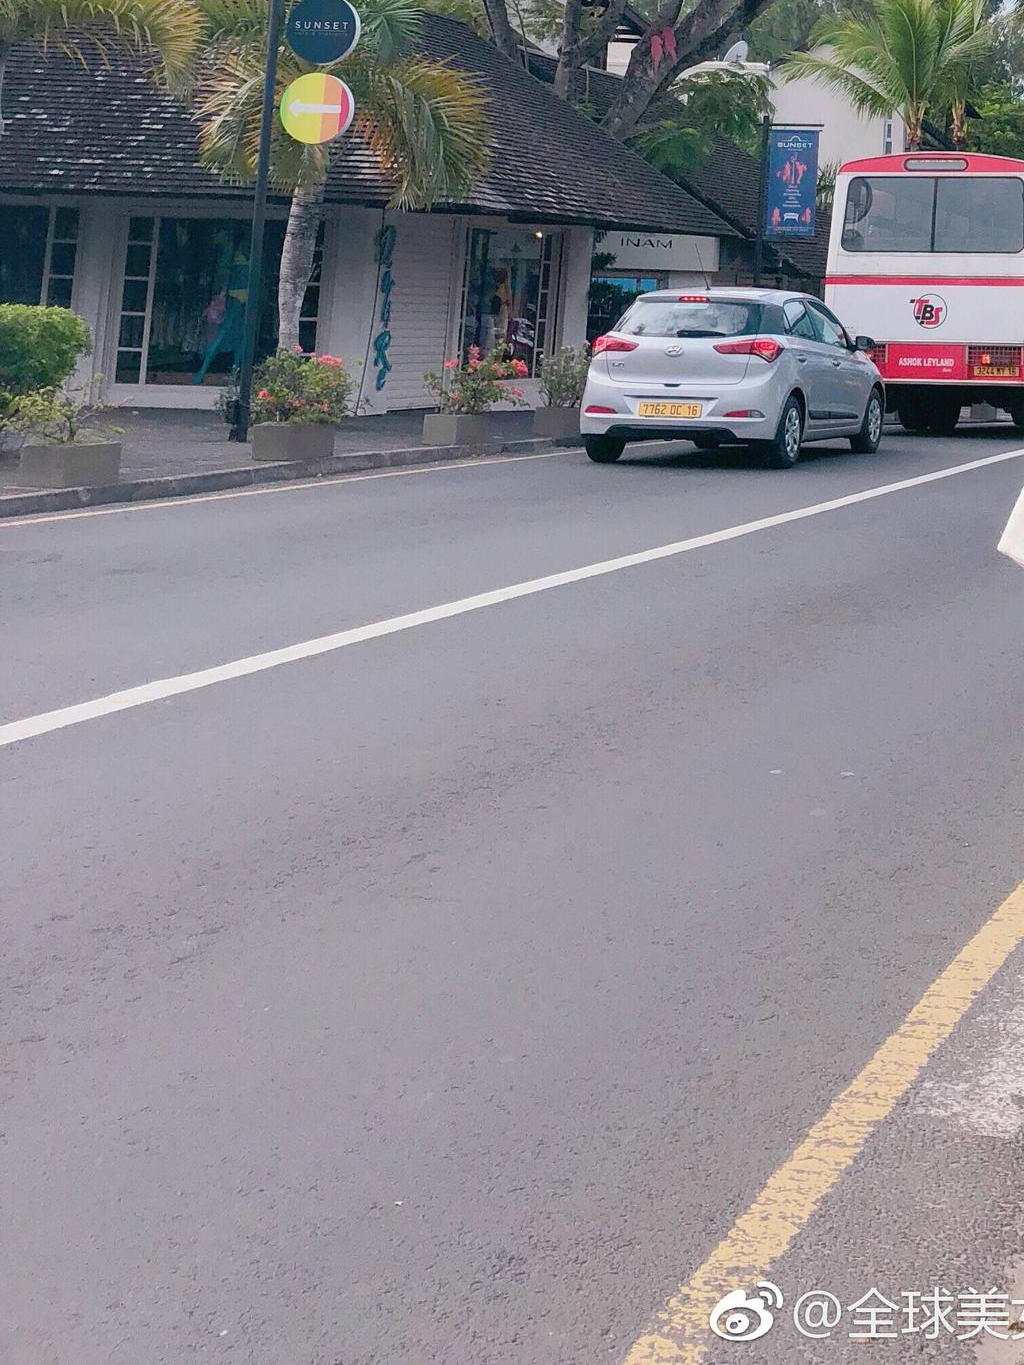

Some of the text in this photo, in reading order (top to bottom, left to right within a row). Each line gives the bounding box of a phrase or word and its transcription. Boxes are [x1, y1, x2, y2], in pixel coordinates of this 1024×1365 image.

[295, 21, 349, 30] SUNSET
[898, 357, 922, 367] ASHOK
[643, 404, 667, 415] 7762
[687, 406, 698, 416] 16
